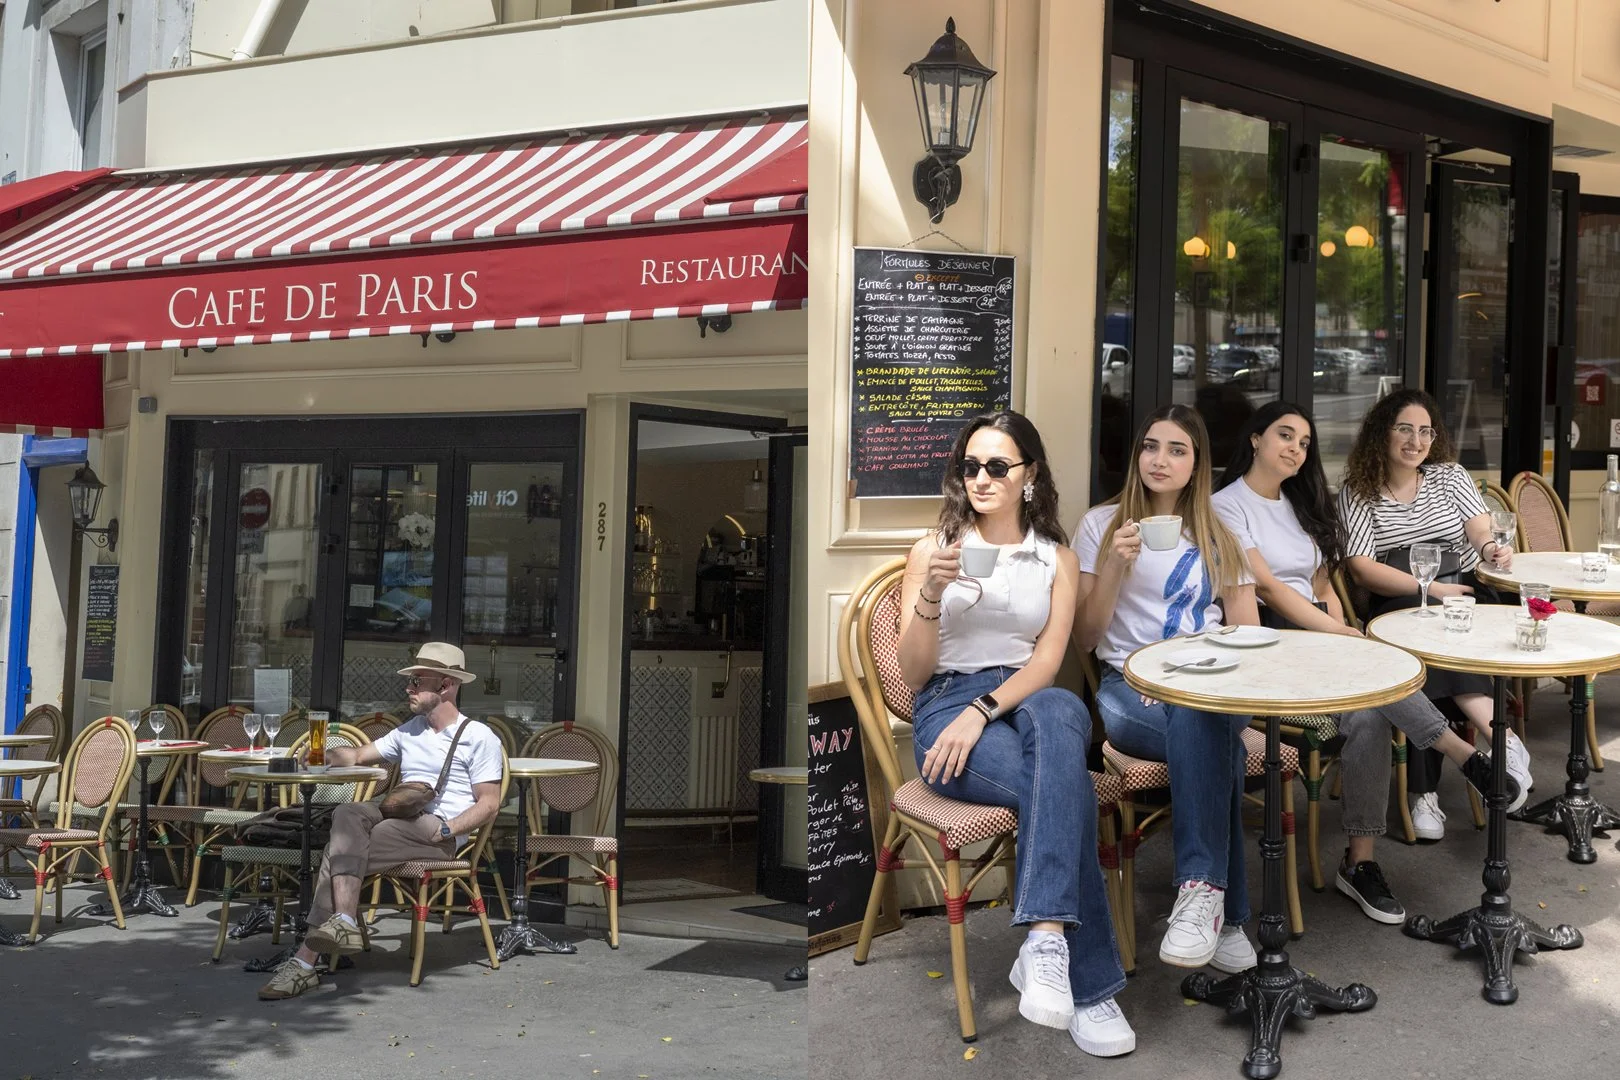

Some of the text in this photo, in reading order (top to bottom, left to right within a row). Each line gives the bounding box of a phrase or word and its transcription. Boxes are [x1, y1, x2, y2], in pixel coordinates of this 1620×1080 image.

[884, 254, 931, 269] FORMULES
[858, 278, 892, 290] ENTRÉE
[906, 281, 928, 290] PLAT
[940, 282, 960, 292] PLAT
[964, 284, 996, 294] DESSERT
[168, 270, 479, 329] CAFE DE PARIS
[865, 292, 896, 302] ENTRÉE
[908, 294, 928, 302] PLAT
[938, 296, 977, 304] DESSERT
[863, 314, 902, 324] TERRINE
[922, 316, 964, 325] CAMPAGNE
[864, 324, 900, 332] ASSIETTE
[920, 326, 971, 334] CHARCUTERIE
[864, 352, 899, 360] TOMATES
[934, 352, 956, 360] PESTO
[866, 367, 916, 376] BRANDADE
[870, 394, 902, 402] SALADE
[889, 462, 929, 470] GOURMAND
[596, 502, 606, 552] 287
[808, 727, 854, 758] WAY
